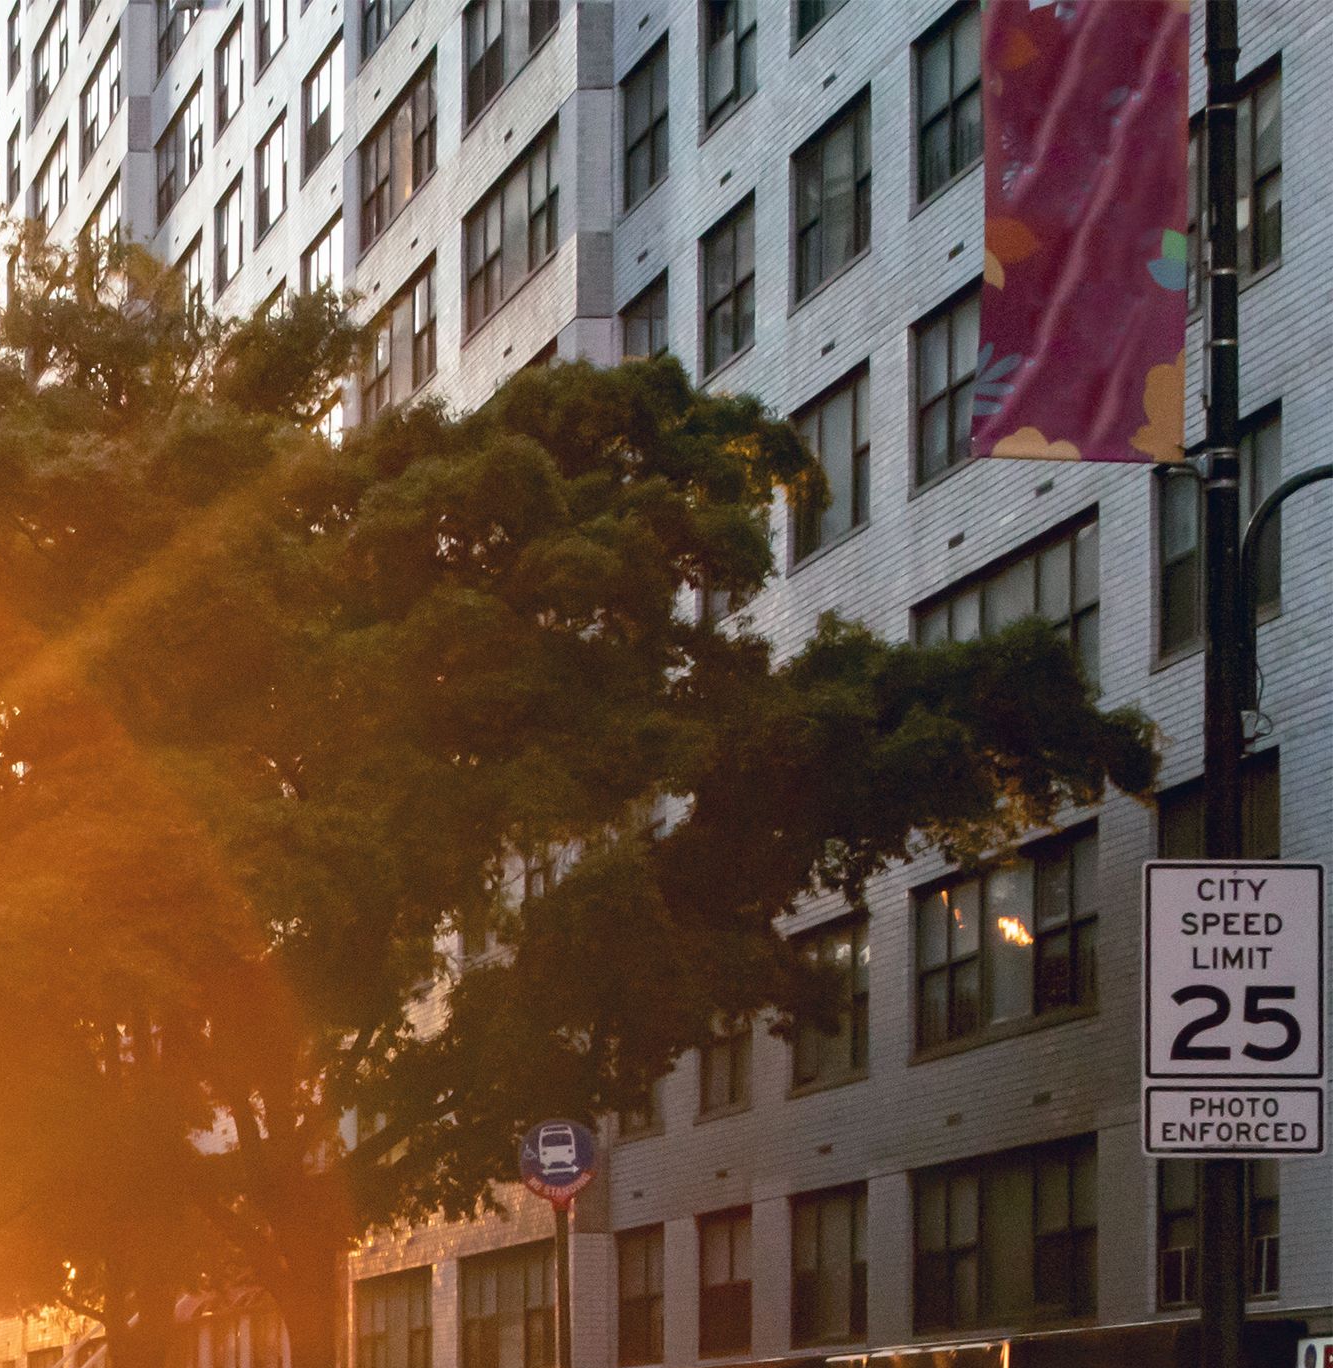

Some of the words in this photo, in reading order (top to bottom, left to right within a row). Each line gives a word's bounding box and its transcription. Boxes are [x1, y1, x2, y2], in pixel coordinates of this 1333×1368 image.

[1197, 878, 1267, 901] CITY
[1181, 912, 1283, 935] SPEED
[1192, 947, 1272, 969] LIMIT
[1170, 984, 1301, 1061] 25
[1190, 1098, 1279, 1117] PHOTO
[1161, 1122, 1307, 1142] ENFORCED
